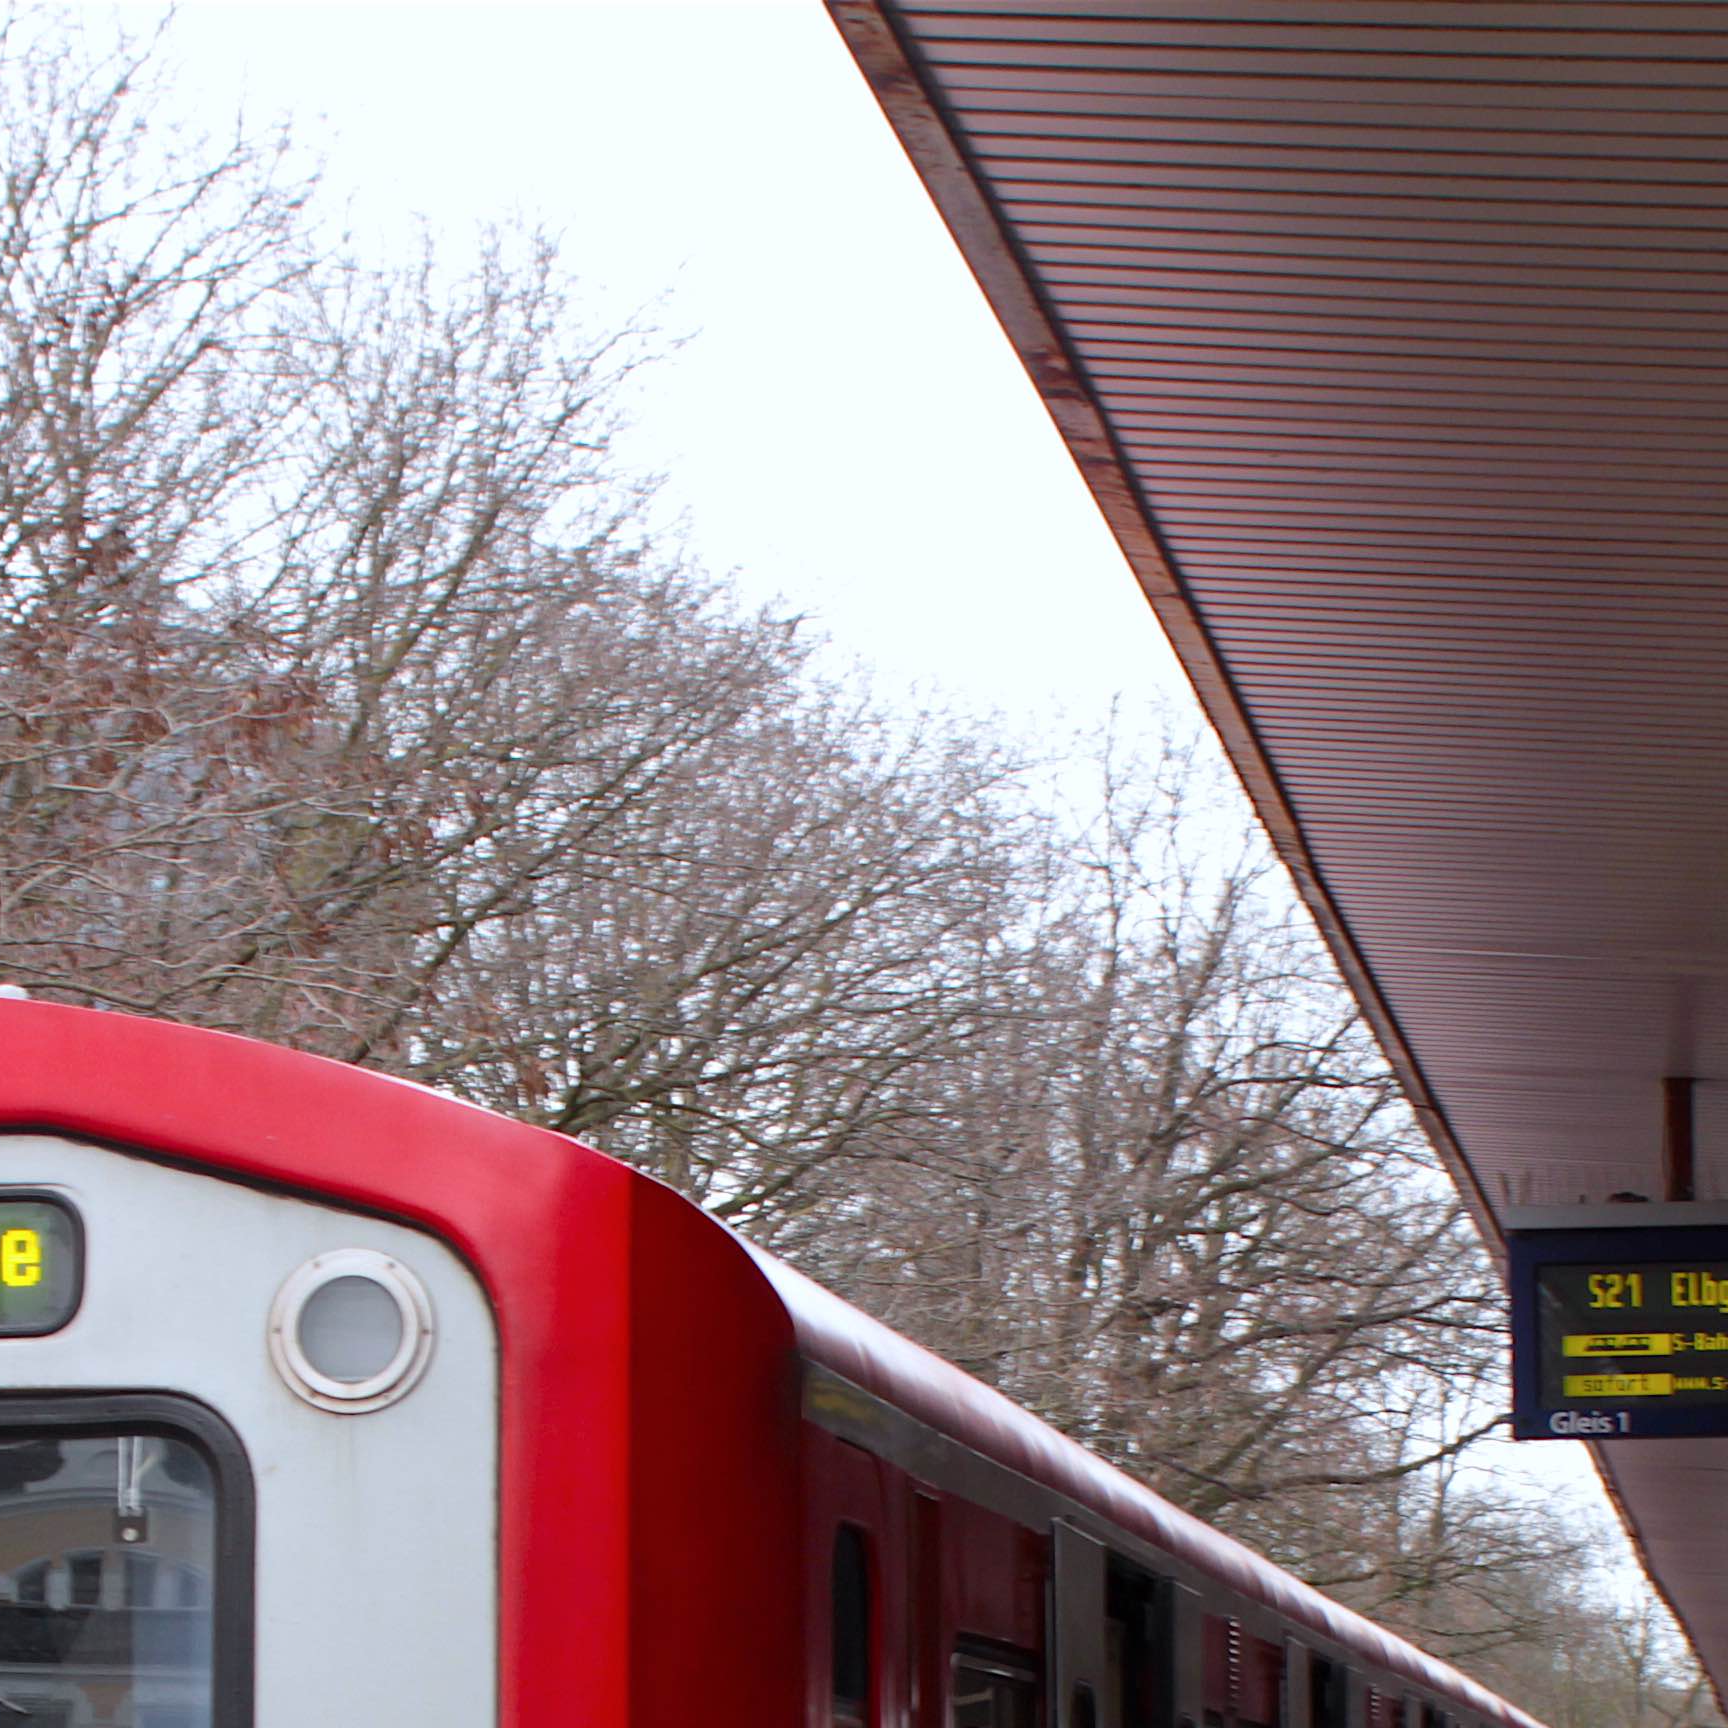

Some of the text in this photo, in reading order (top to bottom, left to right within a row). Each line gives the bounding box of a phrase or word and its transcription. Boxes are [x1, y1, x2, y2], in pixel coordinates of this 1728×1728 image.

[1588, 1272, 1643, 1309] S21
[1583, 1377, 1650, 1394] sofort
[1549, 1410, 1631, 1436] Gleis 1
